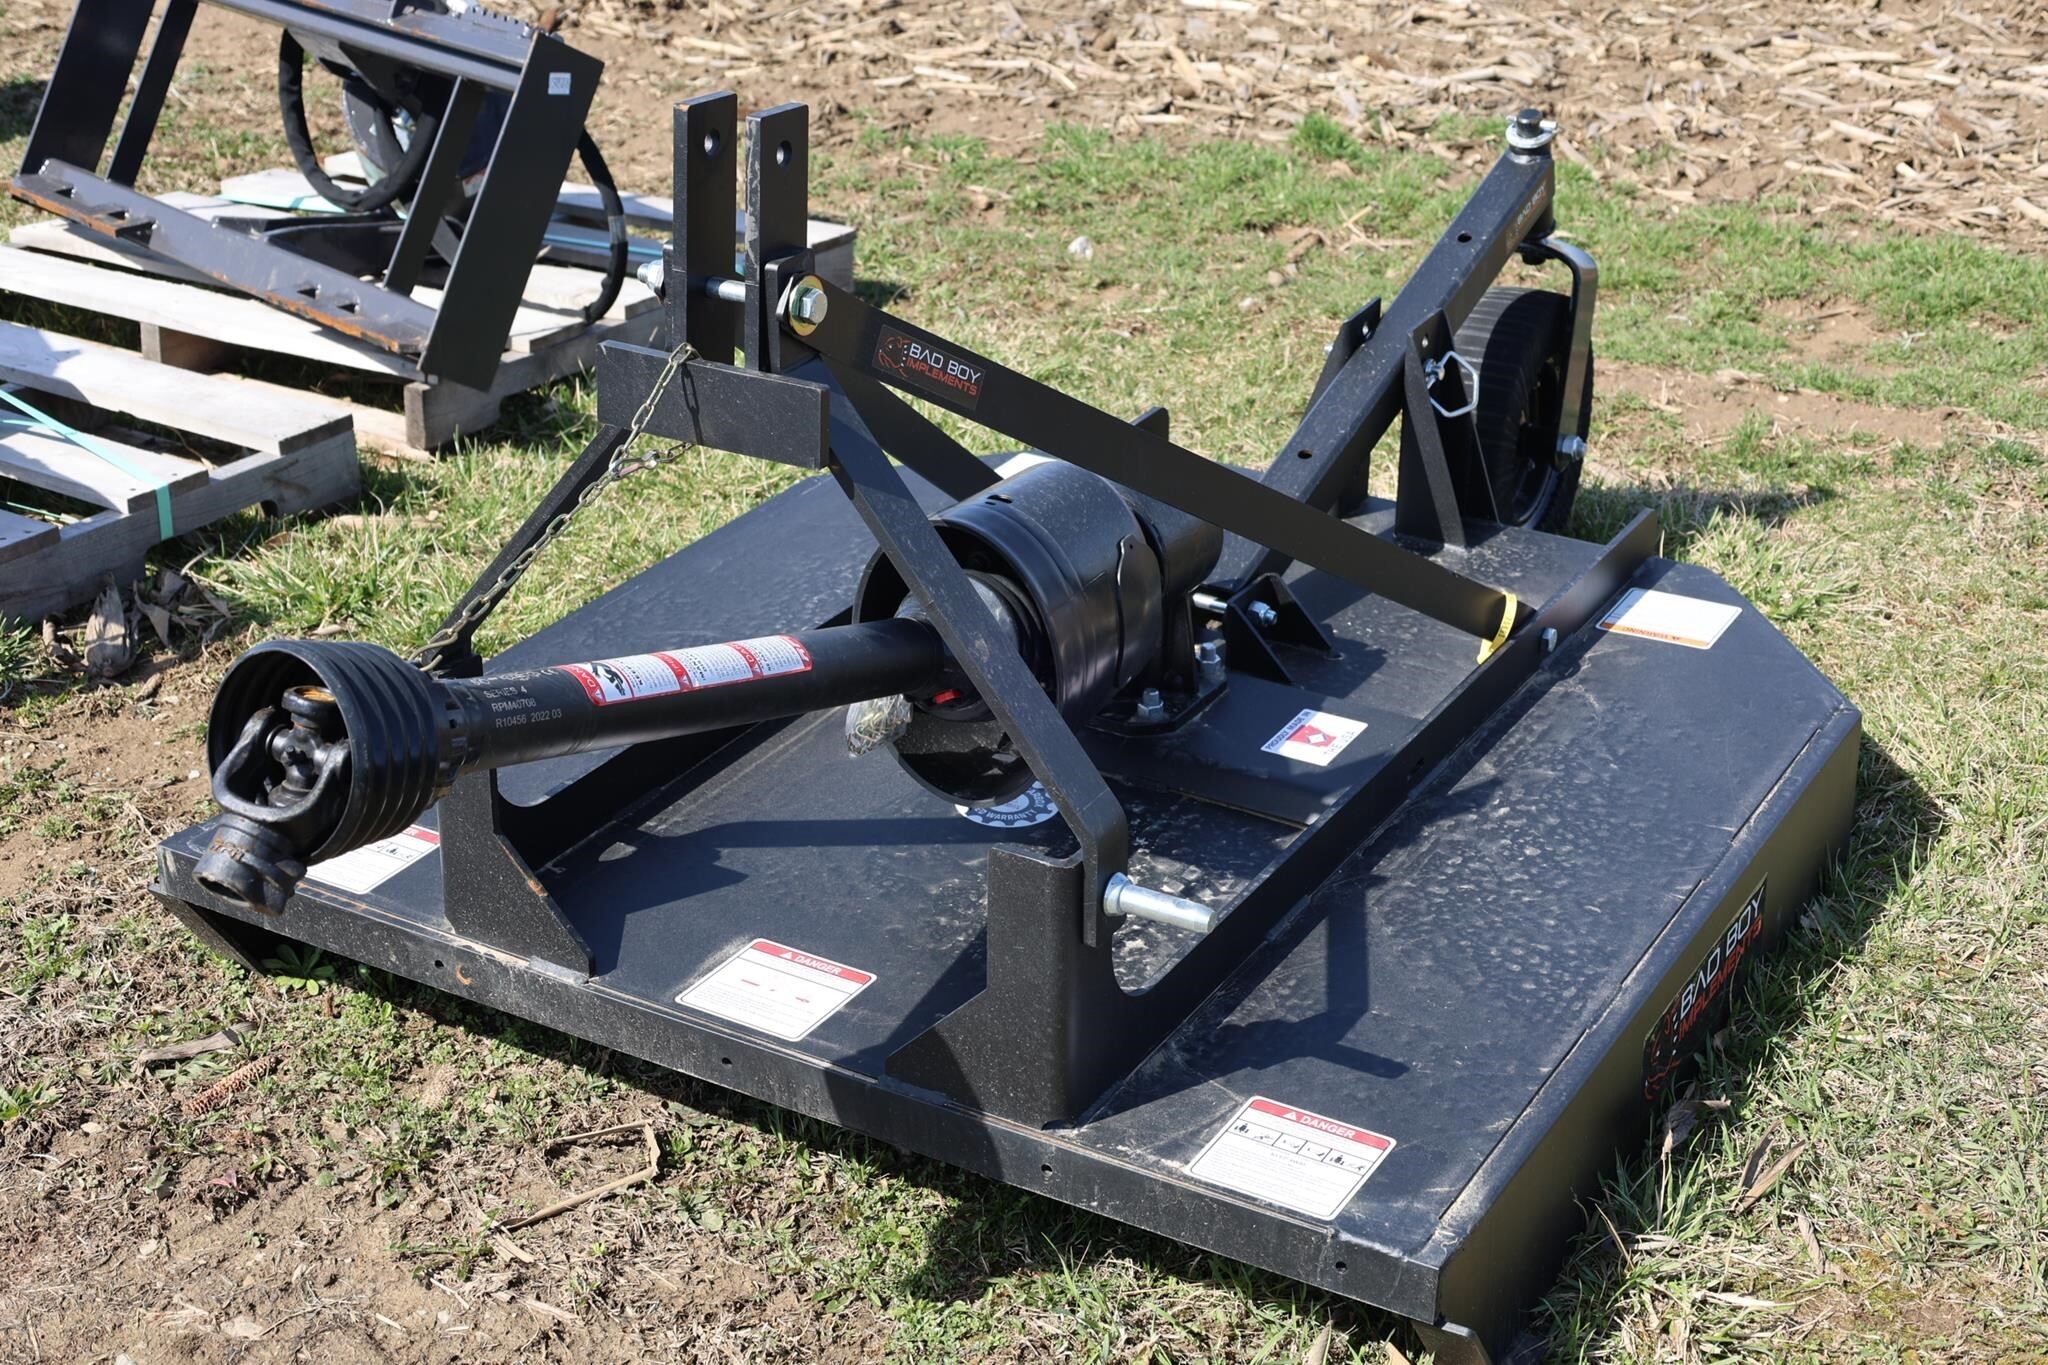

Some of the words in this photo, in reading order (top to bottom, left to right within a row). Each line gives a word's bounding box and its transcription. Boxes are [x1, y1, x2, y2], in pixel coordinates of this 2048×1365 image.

[909, 343, 944, 368] BAD
[947, 360, 981, 383] BOY
[906, 358, 978, 396] IMPLEMENTS
[483, 686, 518, 699] SERIES
[520, 685, 528, 694] 4
[495, 714, 527, 729] R10456
[985, 808, 1037, 821] WARRANTY
[794, 953, 842, 976] DANGER
[1680, 947, 1720, 1020] BAD
[1725, 885, 1766, 958] BOY
[1678, 915, 1763, 1041] IMPLEMENTS
[1299, 1115, 1356, 1139] DANGER
